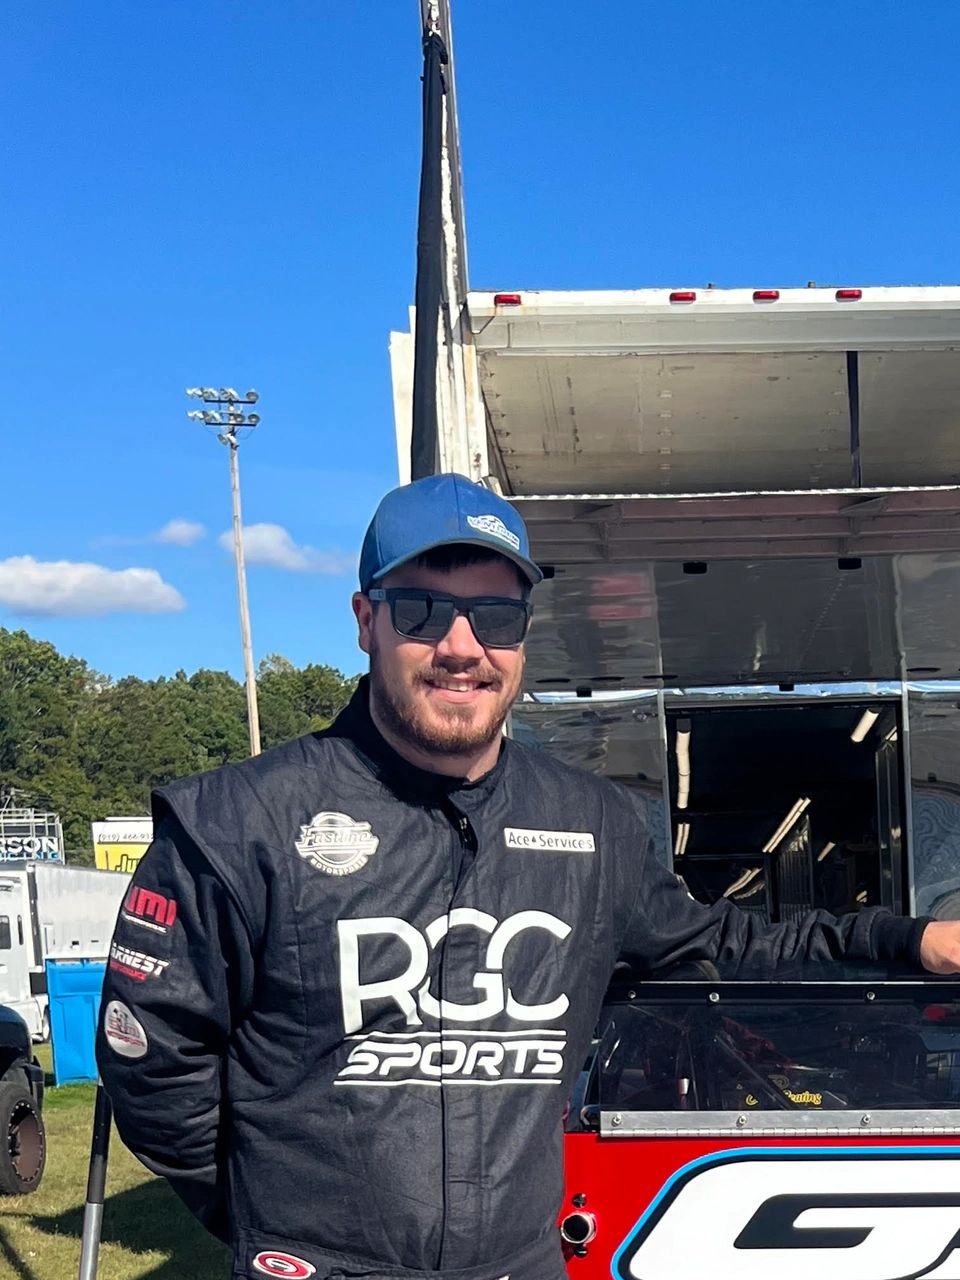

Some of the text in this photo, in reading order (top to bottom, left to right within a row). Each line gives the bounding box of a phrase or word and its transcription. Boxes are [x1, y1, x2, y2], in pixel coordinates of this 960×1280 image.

[508, 831, 593, 849] Ace Services
[337, 907, 573, 1034] RGC
[337, 1040, 568, 1077] SPORTS
